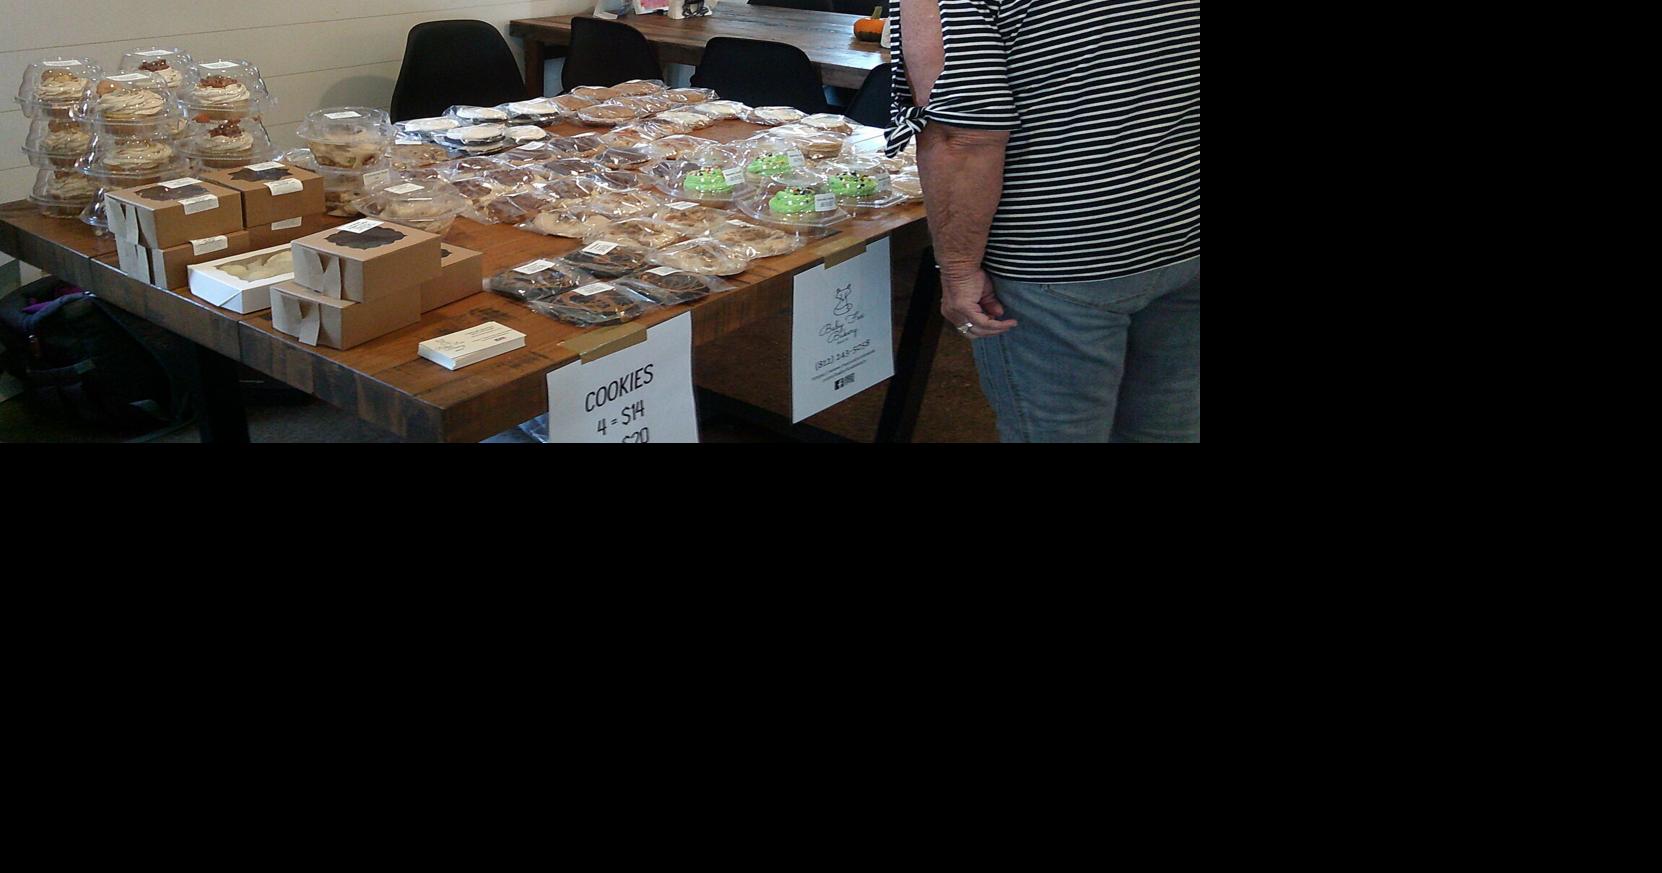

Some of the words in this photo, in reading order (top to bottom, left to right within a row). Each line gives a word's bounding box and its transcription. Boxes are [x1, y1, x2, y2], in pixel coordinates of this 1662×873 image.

[585, 363, 654, 412] COOKIES
[597, 417, 607, 436] 4
[610, 418, 619, 426] =
